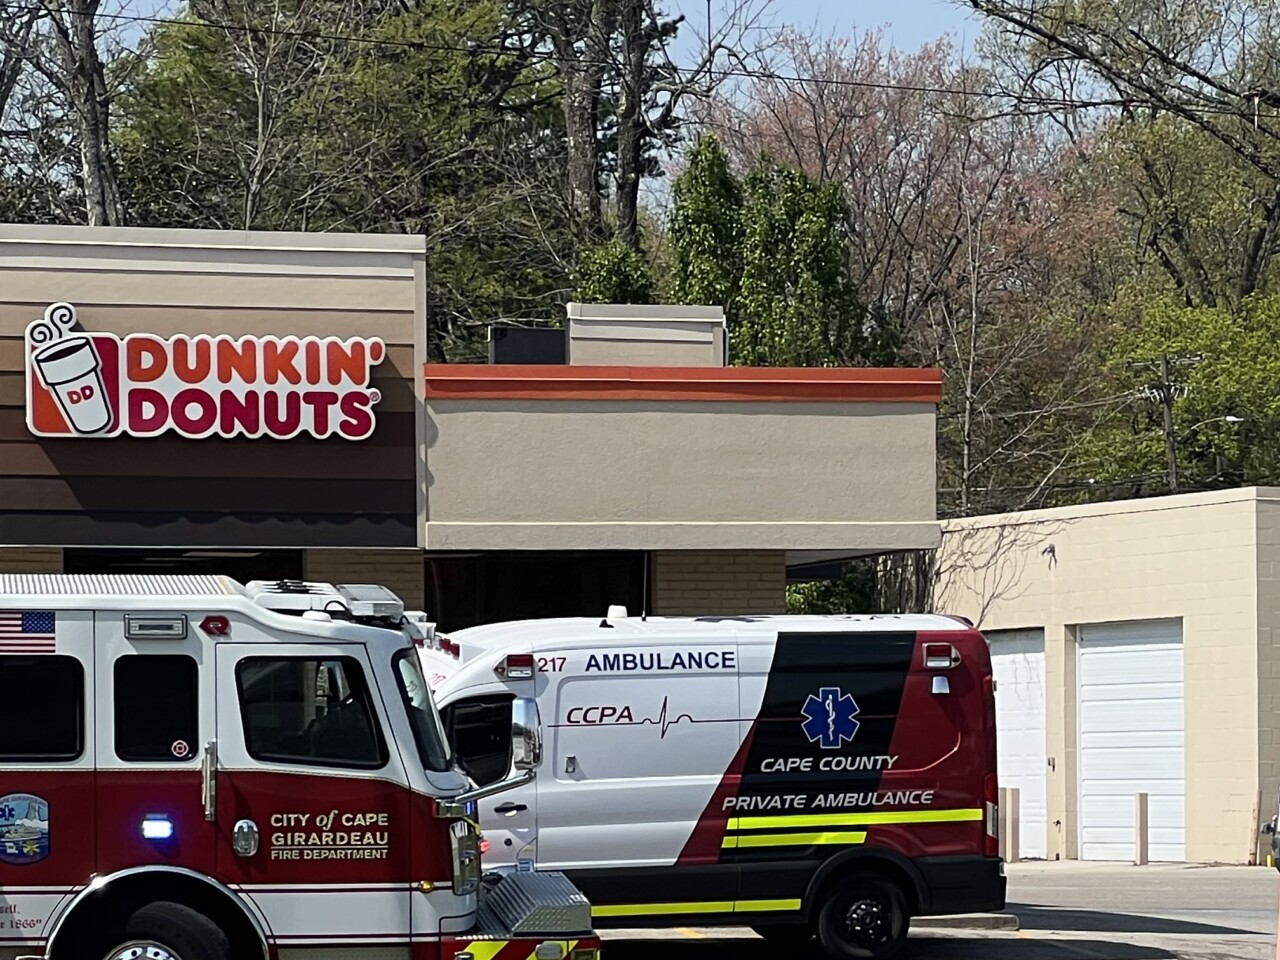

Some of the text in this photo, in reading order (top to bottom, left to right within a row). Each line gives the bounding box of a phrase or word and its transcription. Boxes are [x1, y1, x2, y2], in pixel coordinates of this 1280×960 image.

[127, 337, 383, 386] DUNKIN'
[66, 385, 94, 405] DD
[128, 388, 373, 437] DONUTS
[538, 651, 736, 673] 217 AMBULANCE
[566, 705, 634, 724] CCPA
[760, 755, 899, 772] CAPE COUNTY
[722, 790, 934, 811] PRIVATE AMBULANCE
[270, 809, 389, 831] CITY of CAPE
[271, 831, 389, 845] GIRARDEAU
[271, 849, 389, 860] FIRE DEPARTMENT
